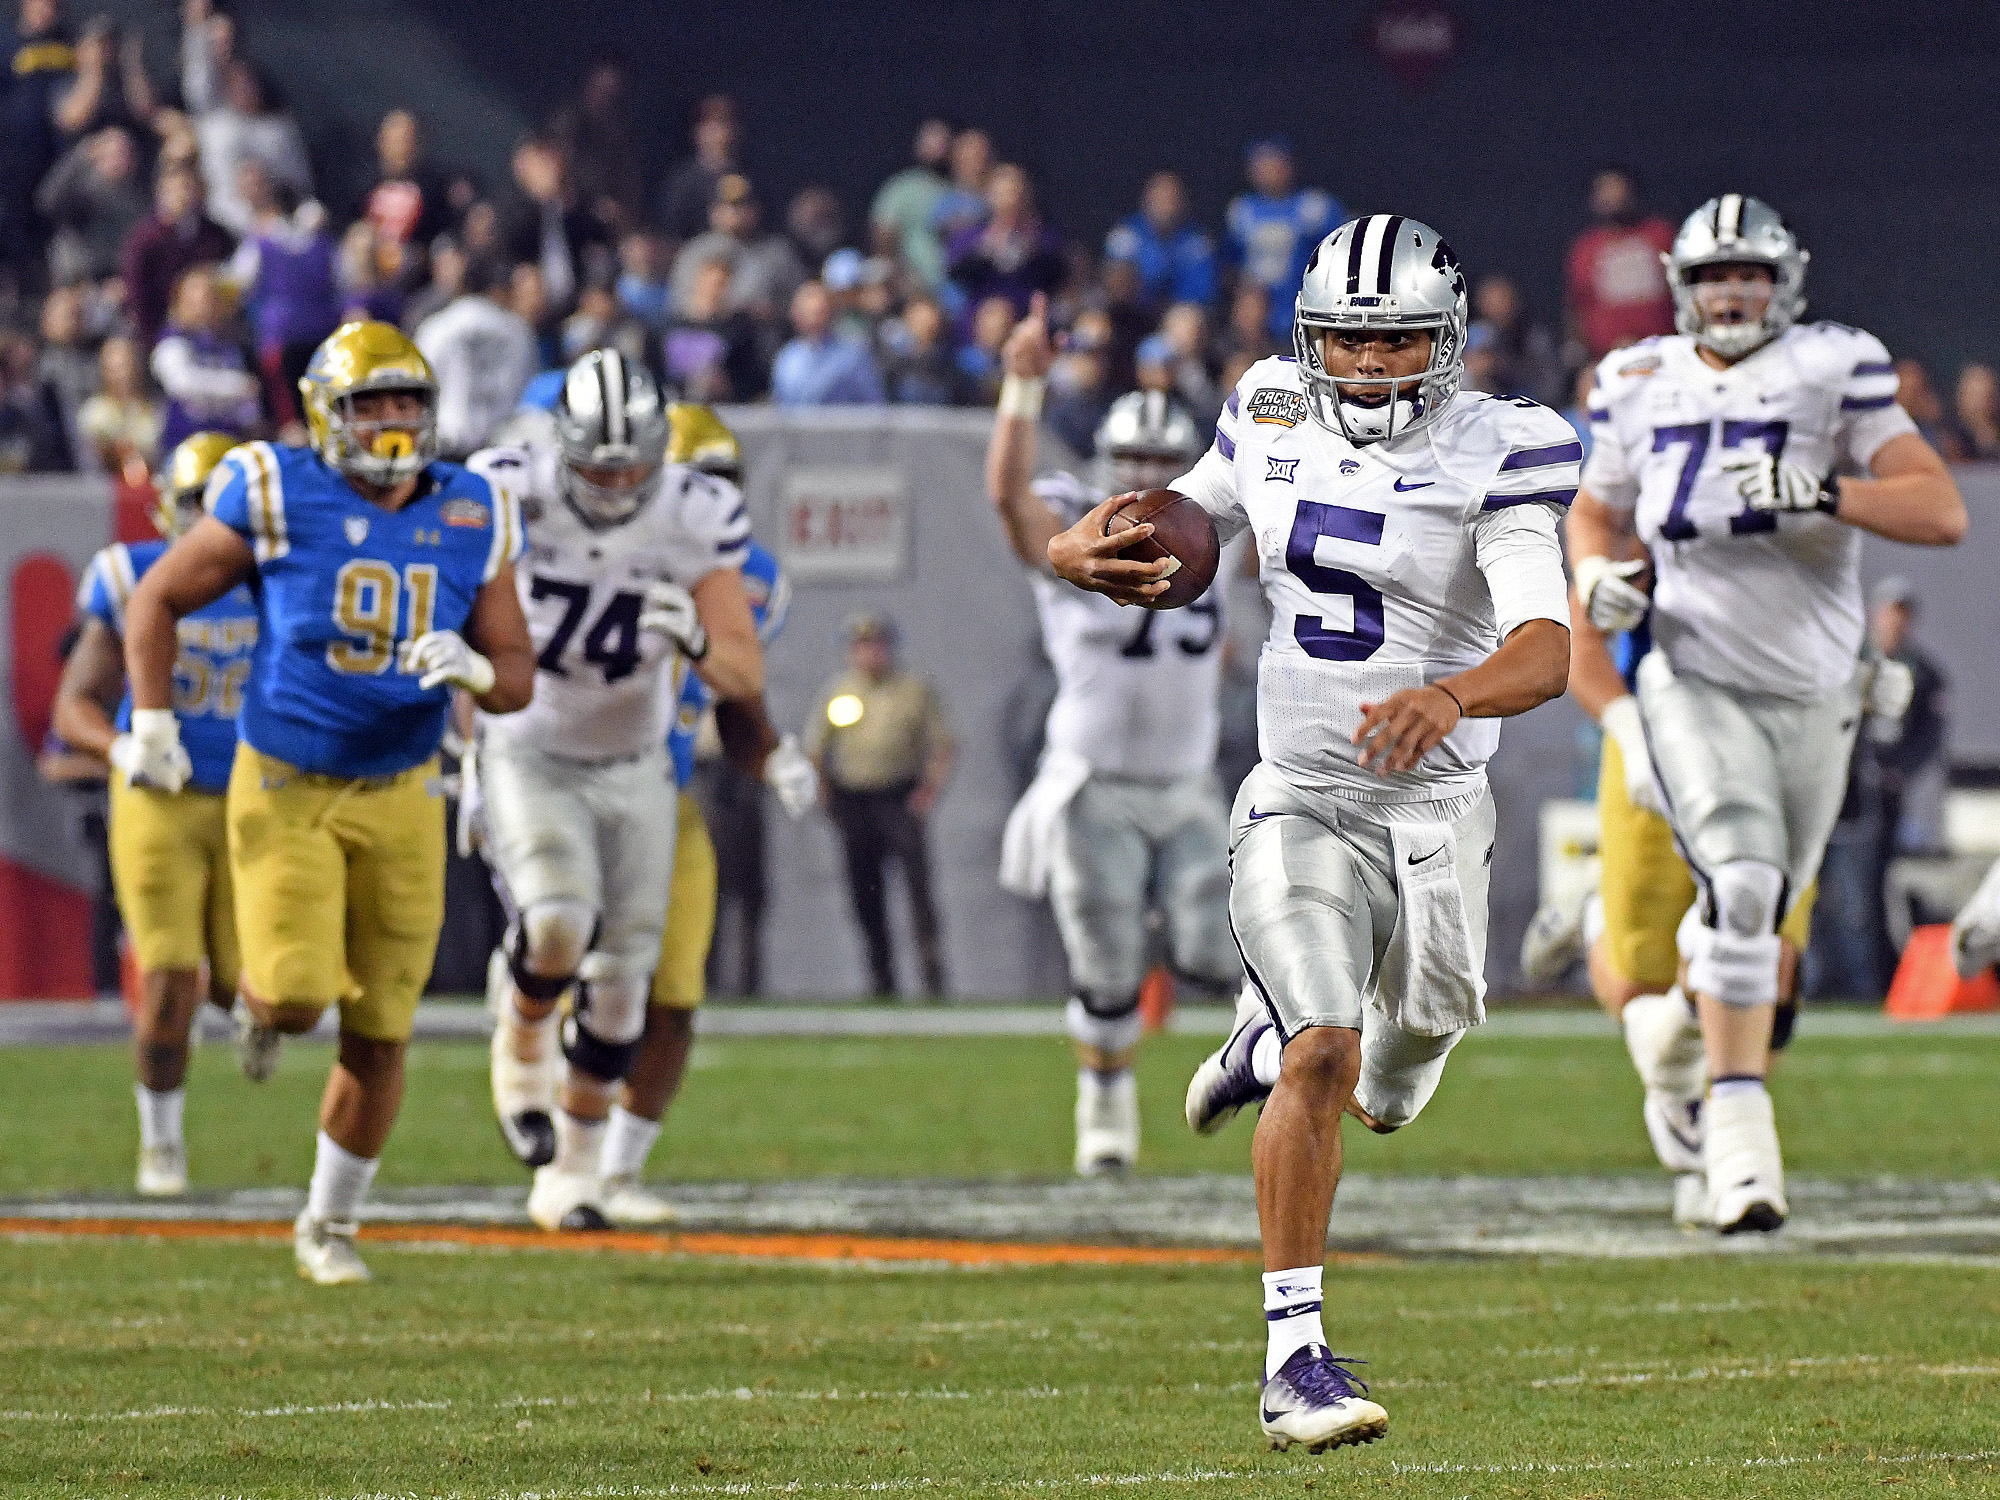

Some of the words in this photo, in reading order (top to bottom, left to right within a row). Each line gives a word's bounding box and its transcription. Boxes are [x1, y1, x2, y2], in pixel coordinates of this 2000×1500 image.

[1253, 390, 1306, 413] CACTUS
[1259, 405, 1296, 420] BOWL
[1652, 418, 1790, 542] 77
[326, 557, 438, 677] 91
[531, 577, 645, 684] 74
[1286, 499, 1386, 662] 5
